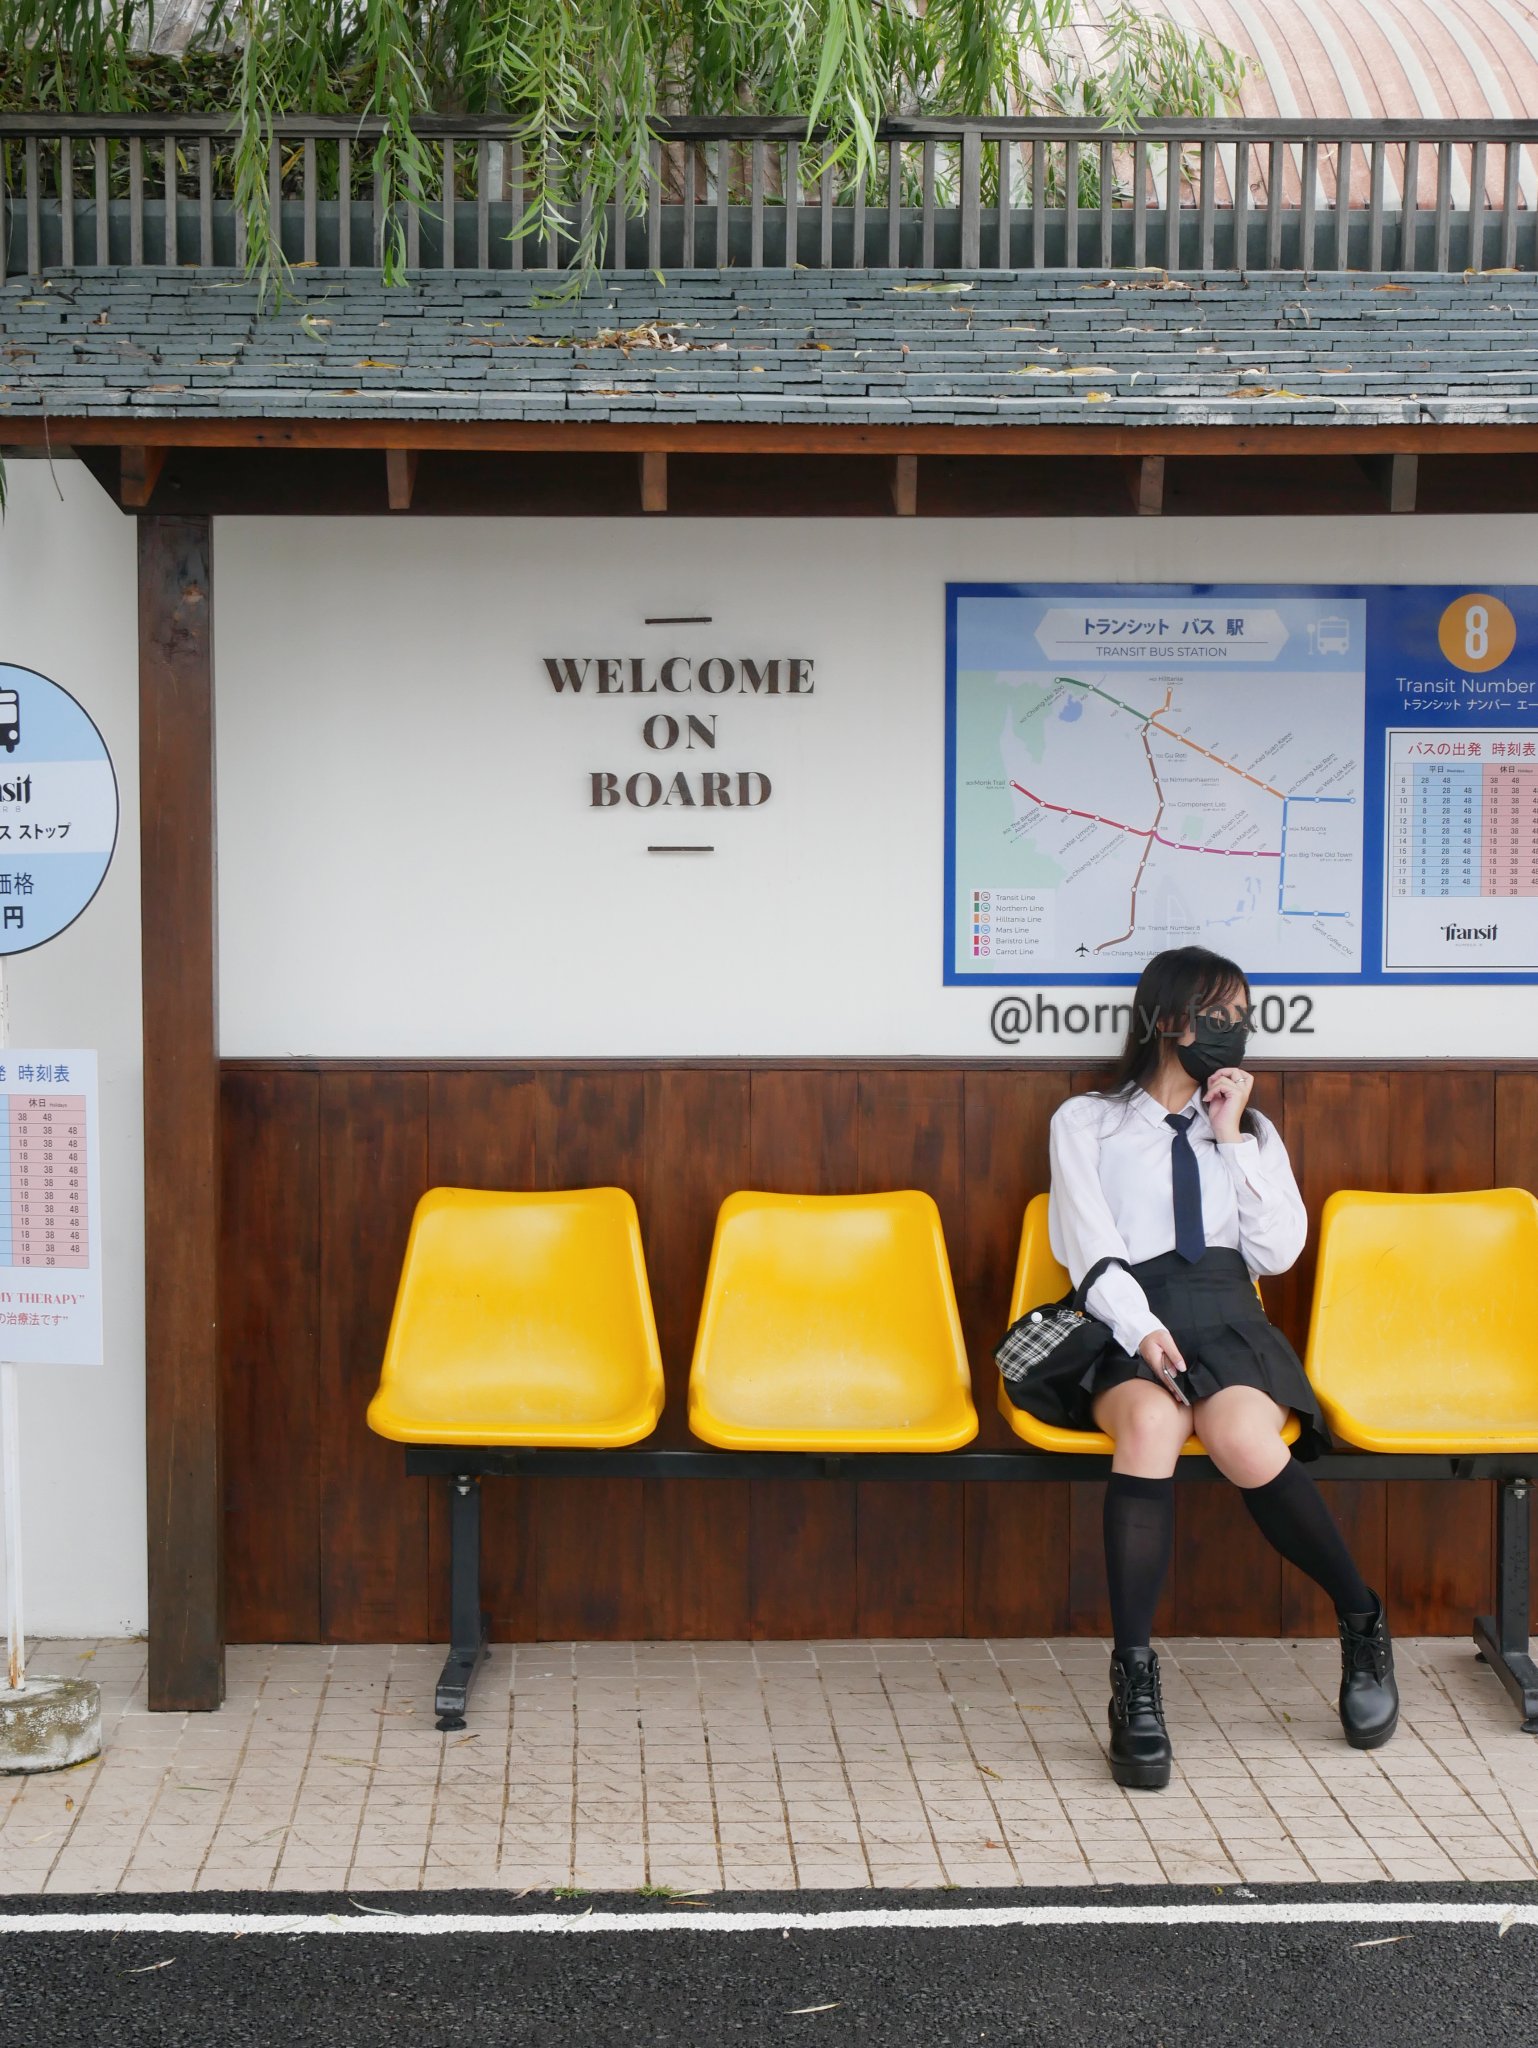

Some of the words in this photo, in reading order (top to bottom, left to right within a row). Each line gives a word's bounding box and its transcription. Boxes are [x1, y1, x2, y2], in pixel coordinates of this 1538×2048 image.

[1085, 618, 1169, 636] トランシット
[1182, 618, 1215, 635] バス
[1226, 618, 1244, 636] 駅
[1465, 605, 1488, 659] 8
[1096, 647, 1145, 656] TRANSIT
[1150, 647, 1174, 657] BUS
[1177, 647, 1227, 657] STATION
[542, 656, 815, 694] WELCOME
[1396, 678, 1455, 693] Transit
[1462, 678, 1535, 693] Number
[1404, 699, 1461, 710] トランシット
[1467, 699, 1511, 710] ナンバー
[643, 714, 718, 750] ON
[1408, 742, 1482, 757] バスの出発
[1492, 742, 1536, 756] 時刻表
[588, 772, 772, 808] BOARD
[19, 822, 72, 840] ストップ
[4, 906, 23, 929] 円
[1440, 923, 1498, 941] Transit
[18, 1064, 70, 1082] 時刻表
[29, 1098, 46, 1108] 休日
[18, 1113, 27, 1121] 38
[42, 1113, 52, 1122] 48
[19, 1126, 28, 1134] 18
[43, 1126, 52, 1135] 38
[68, 1127, 77, 1135] 48
[19, 1139, 28, 1147] 18
[43, 1139, 53, 1148] 38
[68, 1140, 78, 1148] 48
[19, 1152, 28, 1160] 18
[44, 1152, 53, 1161] 38
[68, 1153, 78, 1161] 48
[19, 1165, 28, 1173] 18
[44, 1166, 53, 1174] 38
[68, 1166, 78, 1174] 48
[20, 1178, 29, 1186] 18
[44, 1179, 53, 1187] 38
[69, 1179, 78, 1187] 48
[20, 1191, 29, 1199] 18
[44, 1192, 54, 1200] 38
[69, 1192, 79, 1200] 48
[20, 1204, 29, 1212] 18
[45, 1205, 54, 1213] 38
[69, 1205, 79, 1213] 48
[21, 1217, 30, 1225] 18
[45, 1218, 54, 1226] 38
[70, 1218, 79, 1226] 48
[21, 1230, 30, 1239] 18
[45, 1231, 54, 1239] 38
[70, 1231, 80, 1239] 48
[21, 1243, 30, 1252] 18
[45, 1244, 55, 1252] 38
[70, 1244, 80, 1252] 48
[21, 1256, 30, 1265] 18
[46, 1257, 55, 1265] 38
